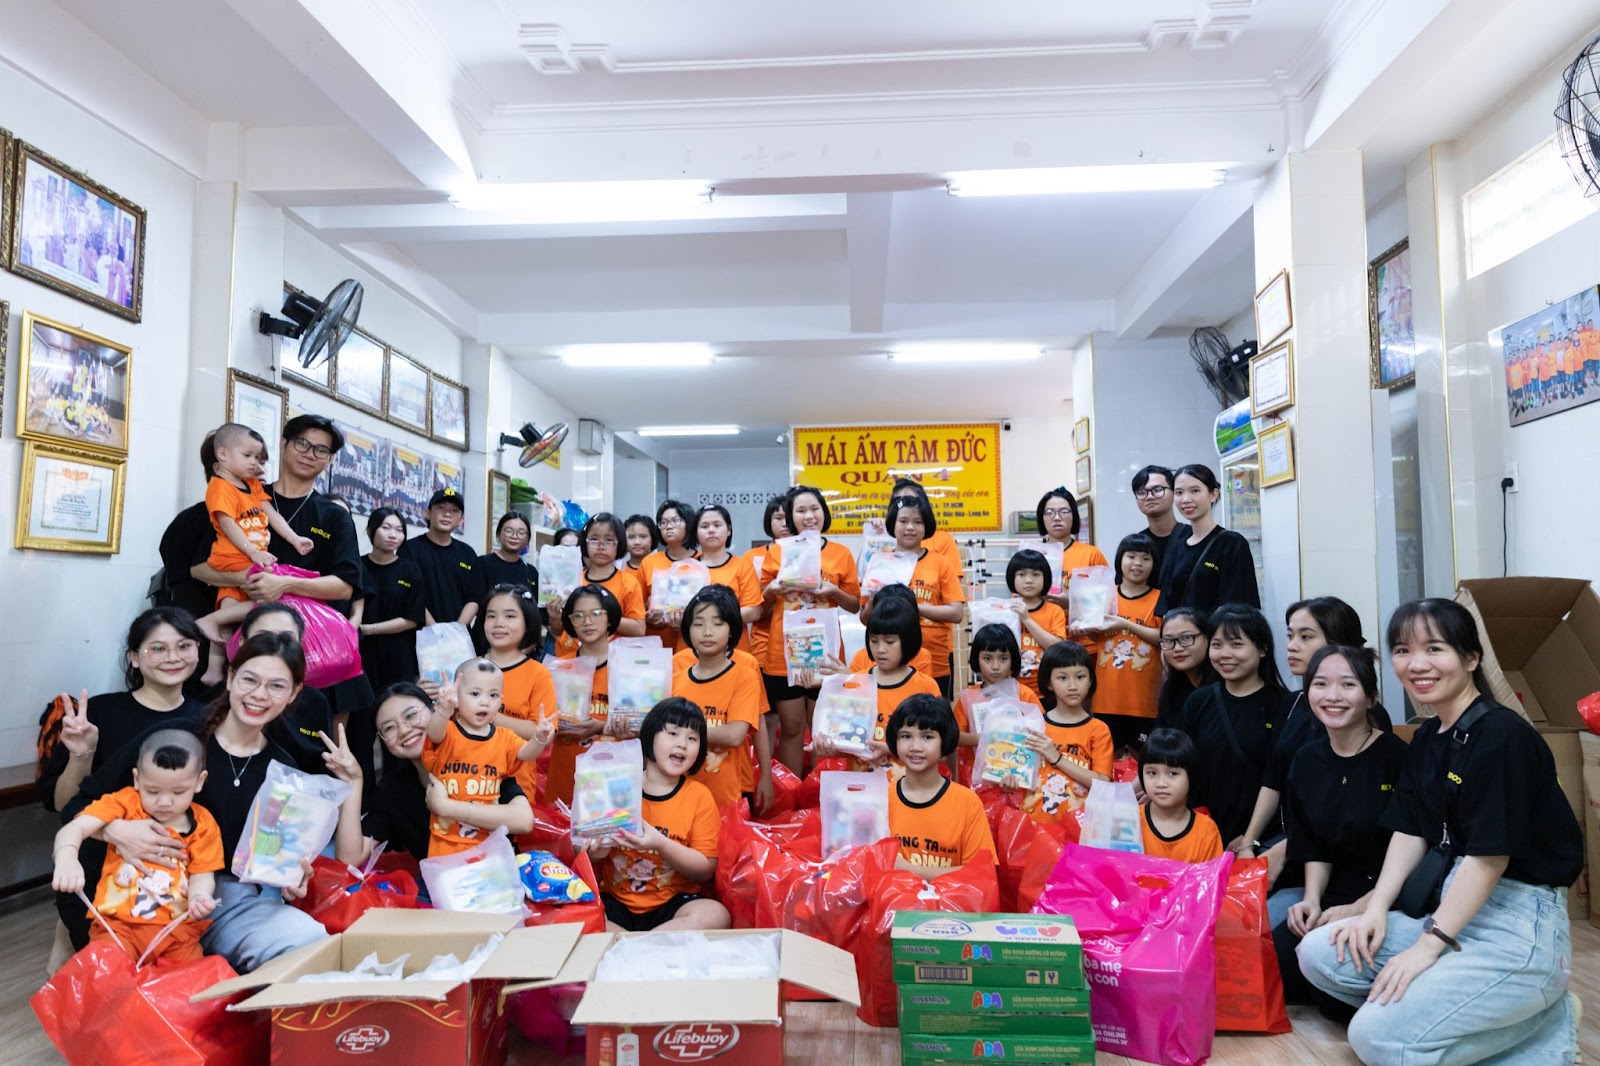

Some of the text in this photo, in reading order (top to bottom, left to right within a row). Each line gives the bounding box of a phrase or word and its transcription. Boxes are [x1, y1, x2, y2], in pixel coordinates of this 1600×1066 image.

[806, 431, 987, 466] MÁI ẤM TÂM ĐỨC
[933, 468, 951, 482] 4
[913, 586, 933, 600] ÌNH
[704, 705, 716, 716] TA
[1066, 743, 1079, 756] TA
[484, 764, 497, 777] TA
[924, 838, 939, 853] TA
[901, 945, 937, 954] VINAMILK
[1100, 961, 1122, 977] mẹ
[1095, 973, 1119, 987] con
[911, 995, 947, 1004] VINAMILK
[342, 1034, 383, 1044] Lifebuoy
[663, 1032, 730, 1046] Lifebuoy
[1103, 1030, 1127, 1039] ONLINE
[911, 1042, 947, 1052] VINAMILK
